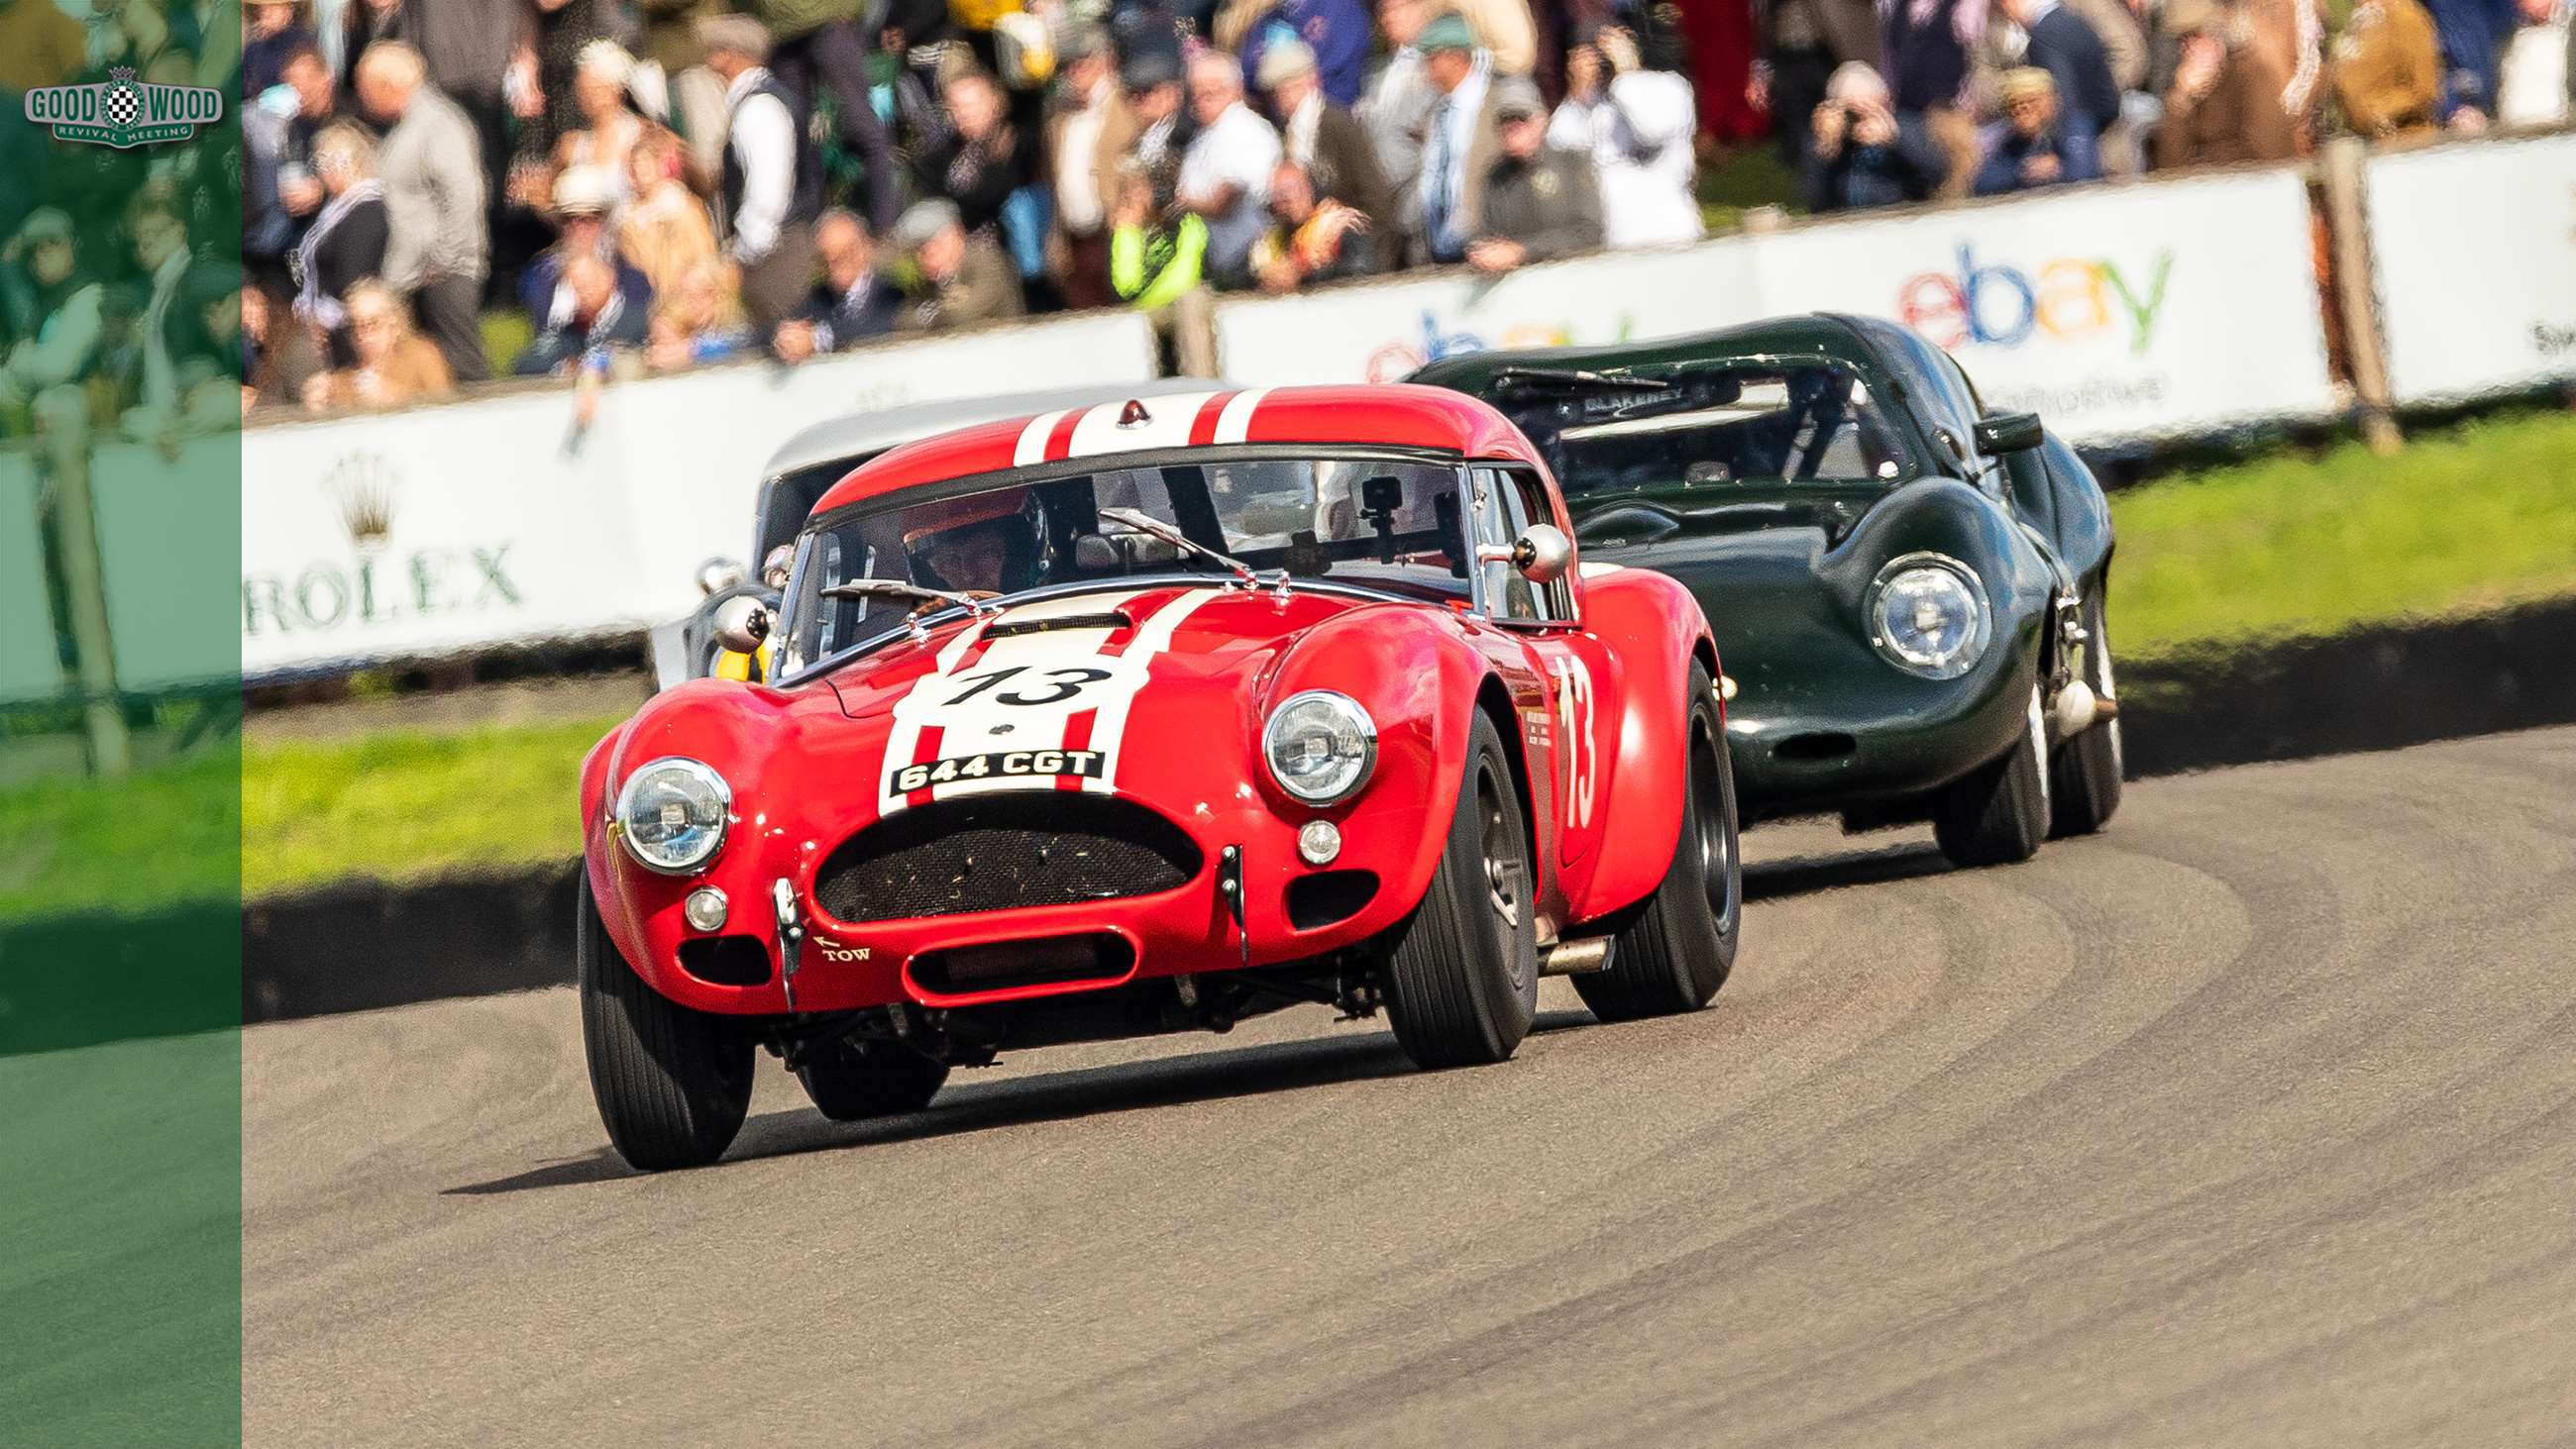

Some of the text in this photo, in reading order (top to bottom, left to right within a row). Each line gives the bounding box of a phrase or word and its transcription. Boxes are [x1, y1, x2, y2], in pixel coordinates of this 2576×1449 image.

[1899, 242, 2174, 356] ebay
[241, 541, 524, 635] ROLEX
[940, 666, 1113, 706] 13
[899, 750, 1099, 791] 644 CGT
[1556, 655, 1596, 829] 13
[821, 948, 871, 962] TOW
